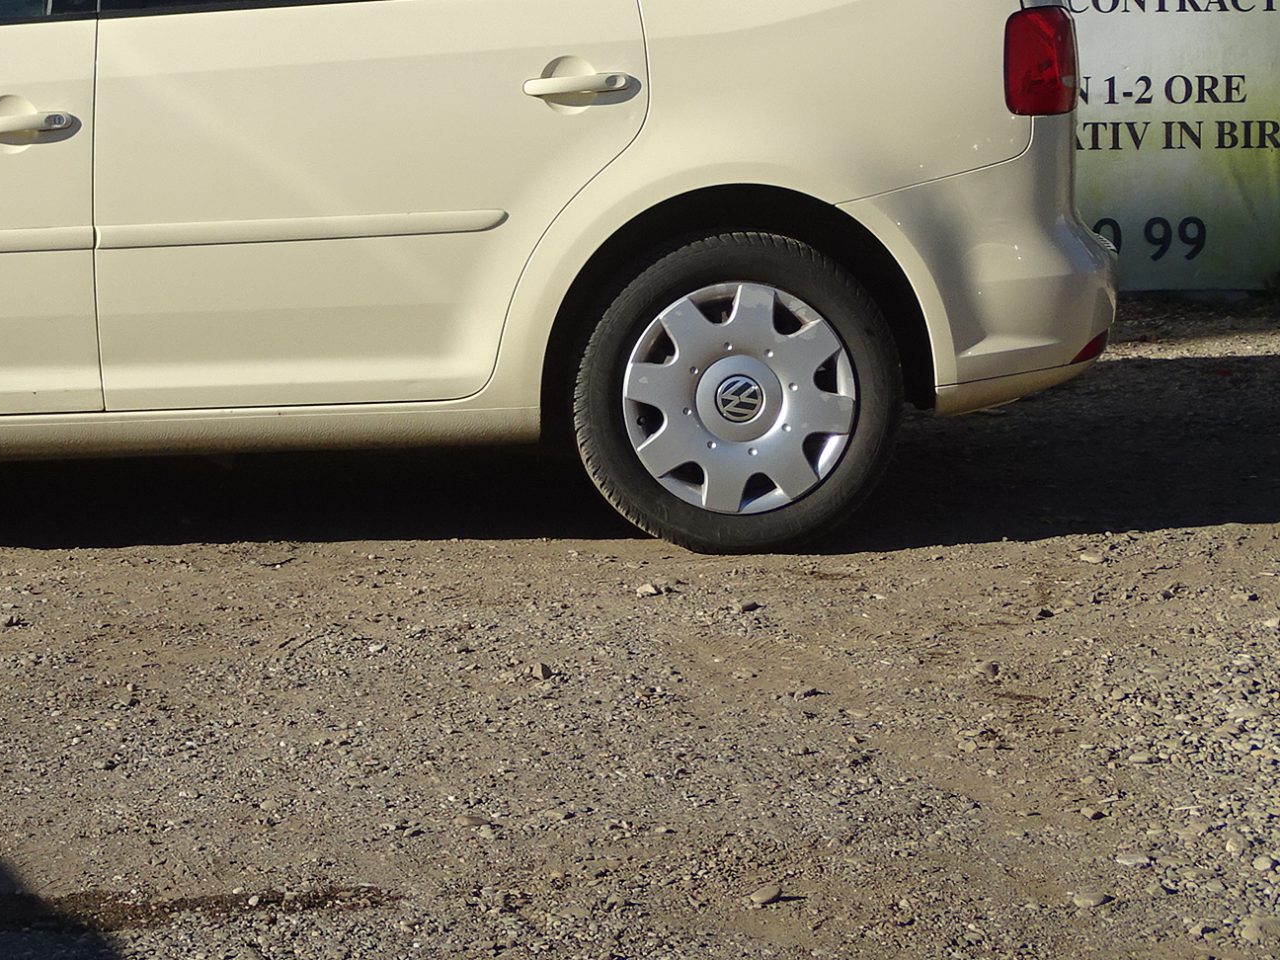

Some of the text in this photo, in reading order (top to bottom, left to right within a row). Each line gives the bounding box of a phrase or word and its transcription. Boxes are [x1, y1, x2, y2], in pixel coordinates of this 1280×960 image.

[1104, 75, 1153, 104] 1-2
[1164, 74, 1248, 104] ORE
[1161, 121, 1204, 150] IN
[1214, 120, 1280, 150] BIR
[1144, 216, 1207, 262] 99
